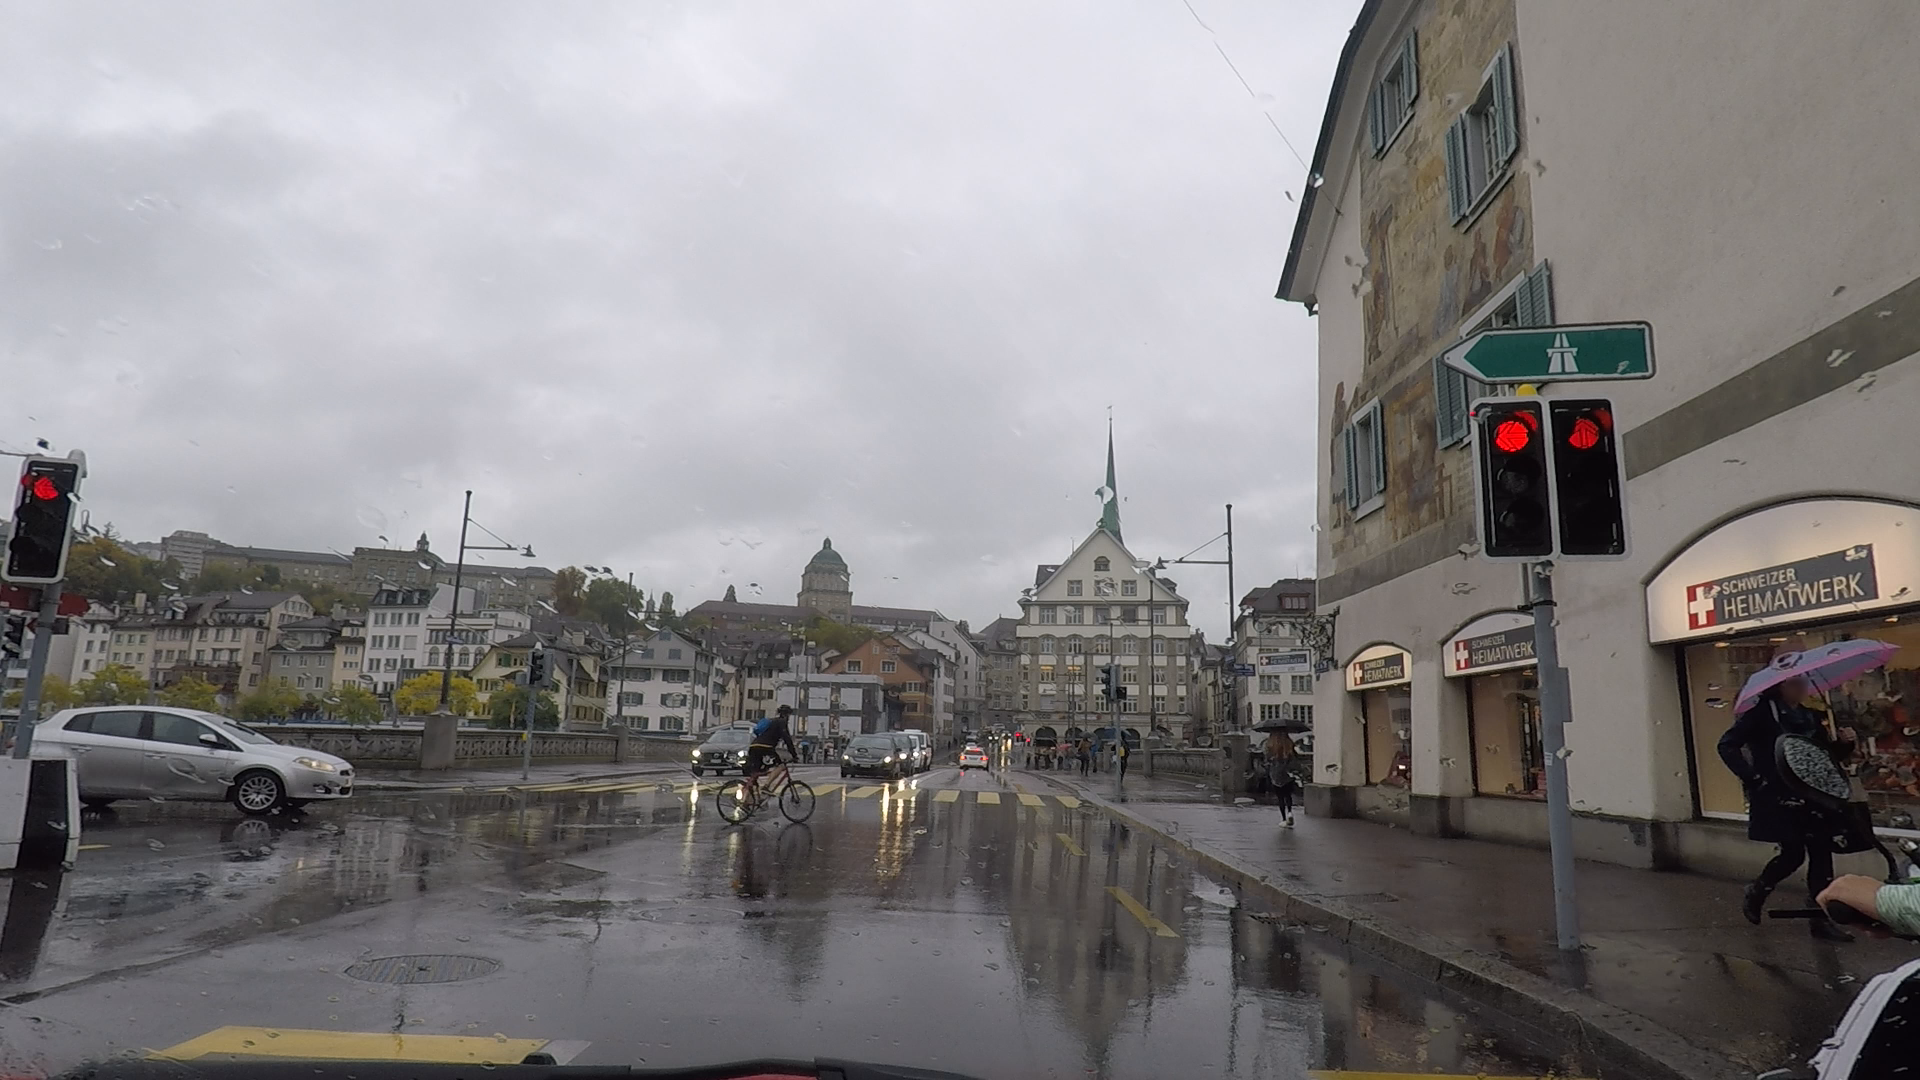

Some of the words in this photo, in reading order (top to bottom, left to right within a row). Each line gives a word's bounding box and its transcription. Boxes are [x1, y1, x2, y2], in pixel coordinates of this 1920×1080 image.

[1721, 568, 1796, 595] SCHWEIZER
[1723, 572, 1865, 620] HEIMATWERK
[1472, 641, 1535, 665] HEIMATWERK
